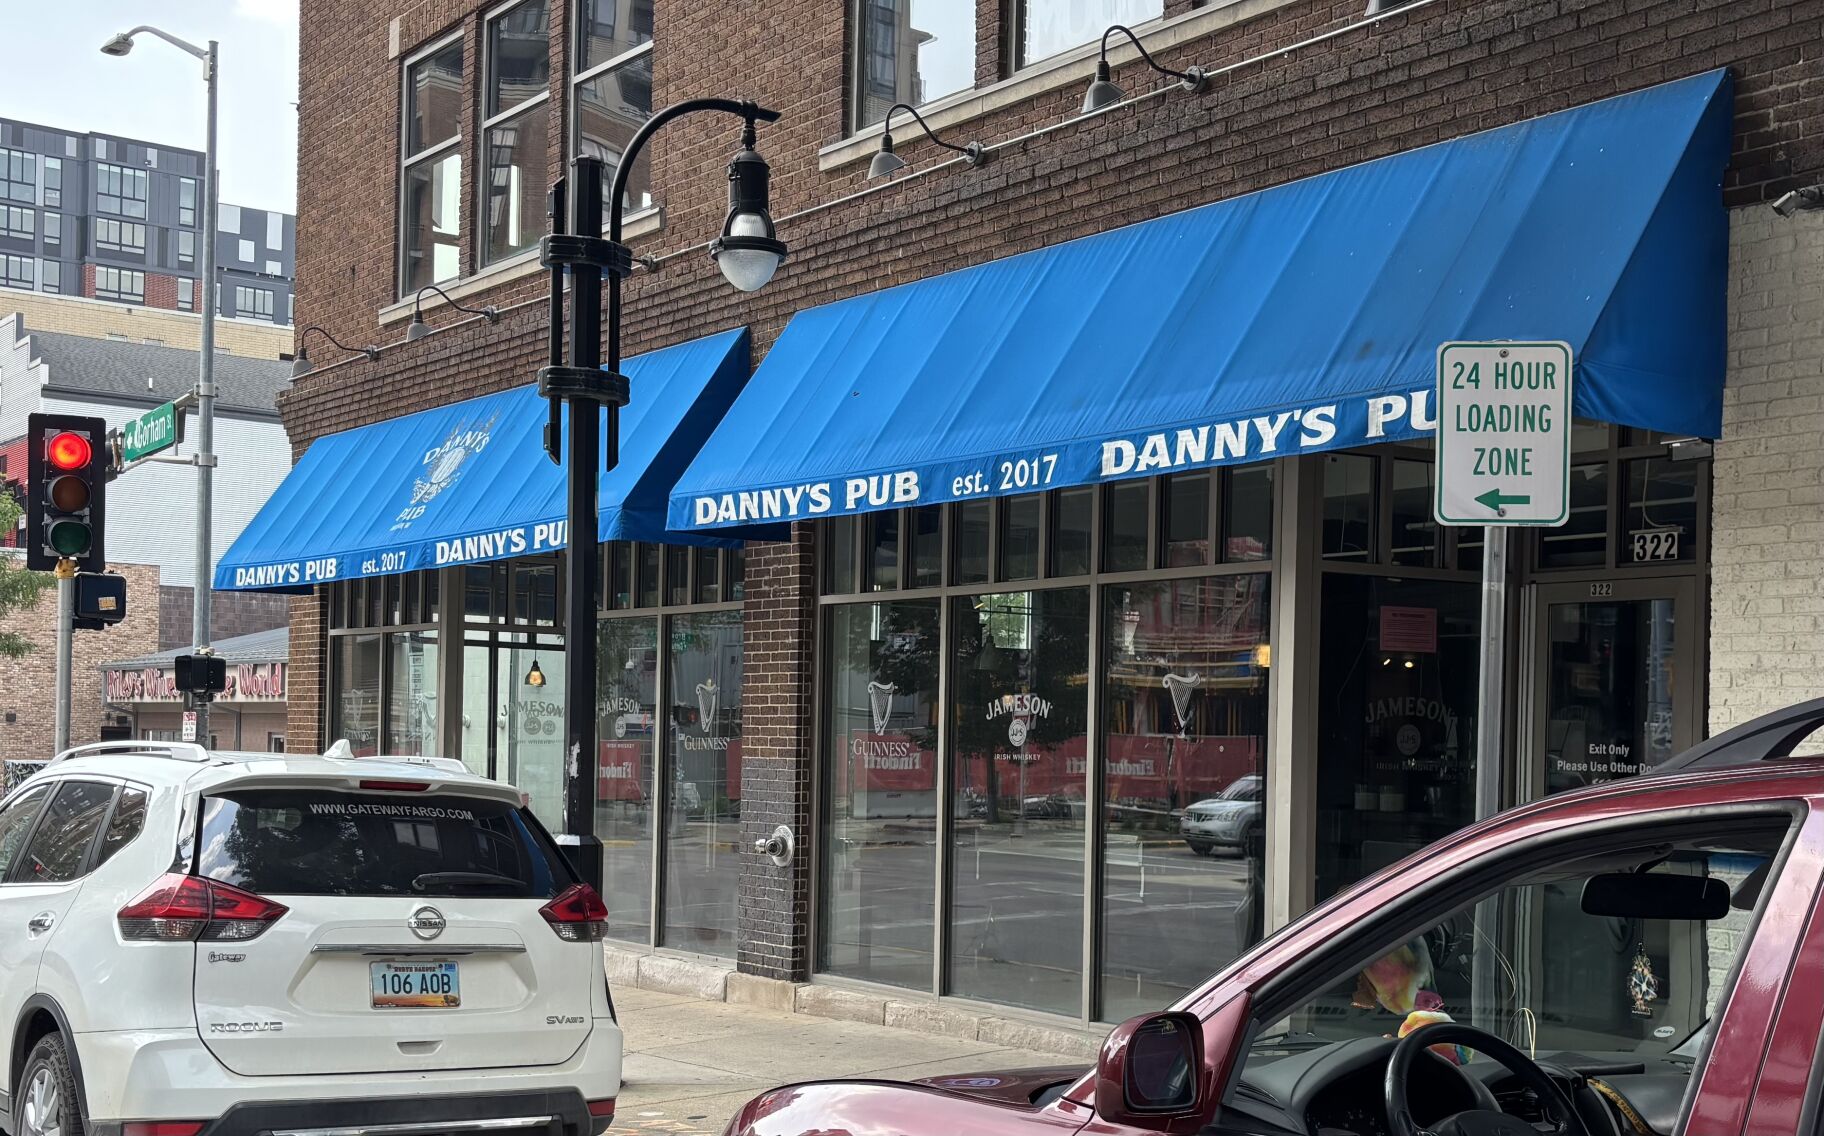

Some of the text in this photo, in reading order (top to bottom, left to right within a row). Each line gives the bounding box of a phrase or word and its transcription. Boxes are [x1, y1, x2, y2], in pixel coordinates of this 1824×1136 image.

[1452, 361, 1556, 390] 24 HOUR
[1456, 404, 1552, 433] LOADING
[134, 416, 166, 449] Gorham
[1100, 390, 1437, 477] DANNY'S PU
[1473, 447, 1533, 476] ZONE
[952, 453, 1058, 496] est. 2017
[695, 470, 920, 526] DANNY'S PUB
[435, 519, 568, 565] DANNY'S PU
[1635, 532, 1676, 561] 322
[235, 557, 337, 587] DANNY'S PUB
[361, 551, 406, 574] est. 2017
[1591, 583, 1612, 596] 322
[238, 663, 282, 696] World
[602, 697, 640, 717] JAMESON
[985, 694, 1050, 721] JAMESON
[1365, 696, 1452, 724] JAMESON
[684, 735, 729, 751] GUINNESS
[853, 738, 908, 757] GUINNESS
[1589, 743, 1630, 757] Exit Only
[993, 753, 1041, 761] IRISH WHISKEY
[1557, 760, 1659, 774] Please Use Other Do
[309, 803, 474, 821] WWW.GATEWAYFARGO.COM
[413, 920, 443, 928] NISSAN
[208, 951, 247, 963] Gateway
[381, 973, 413, 995] 106
[210, 1021, 283, 1033] ROGUE
[546, 1015, 565, 1024] SV
